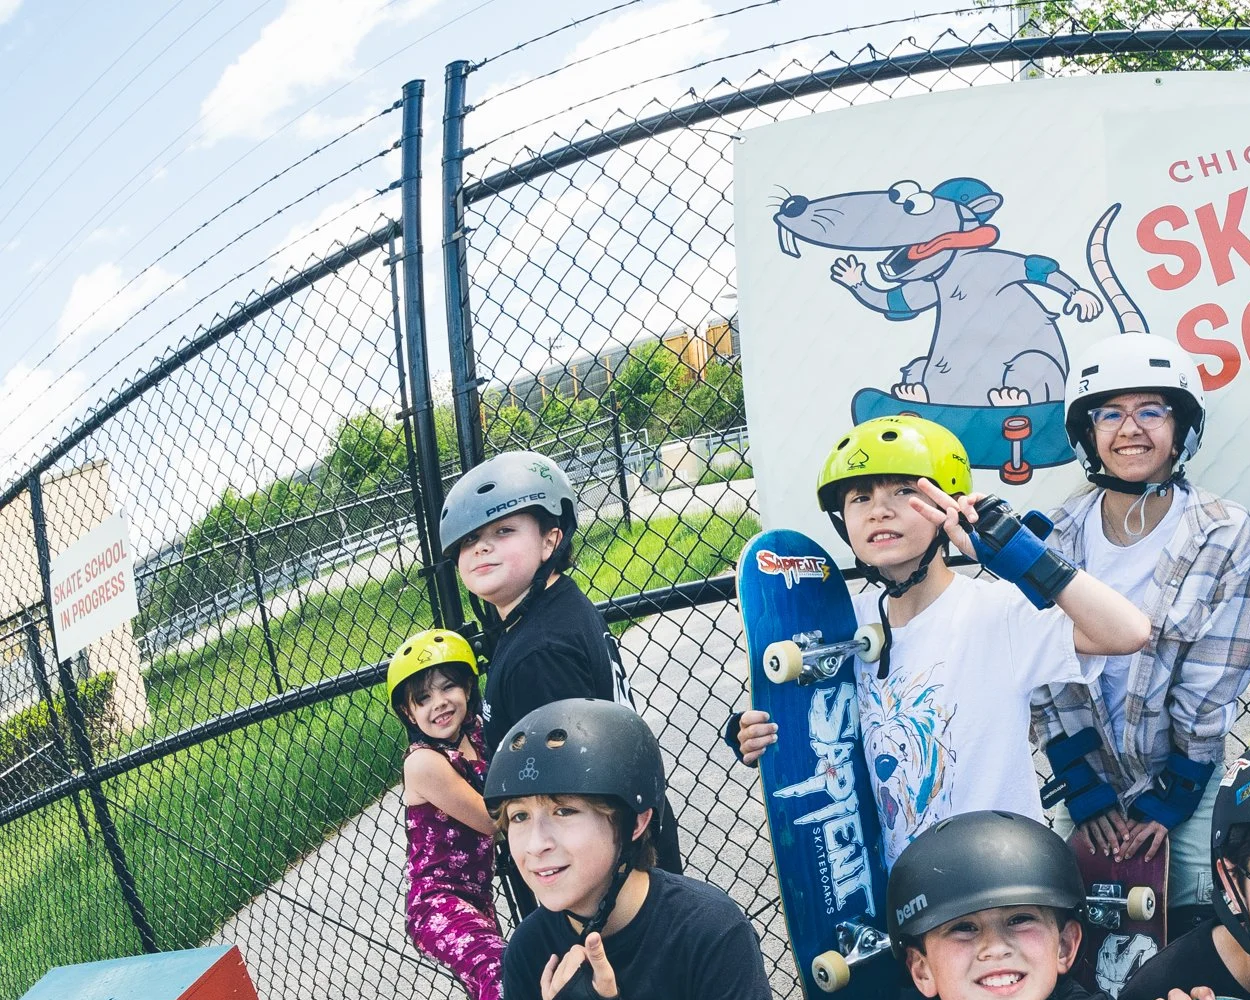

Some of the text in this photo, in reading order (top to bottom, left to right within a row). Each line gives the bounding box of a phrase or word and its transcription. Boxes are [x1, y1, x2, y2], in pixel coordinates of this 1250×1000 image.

[486, 492, 546, 517] PRO-TEC
[53, 539, 127, 605] SKATE SCHOOL
[60, 571, 126, 631] IN PROGRESS
[773, 682, 876, 918] SAPIENT
[813, 827, 834, 915] SKATEBOARDS
[896, 894, 928, 926] bern
